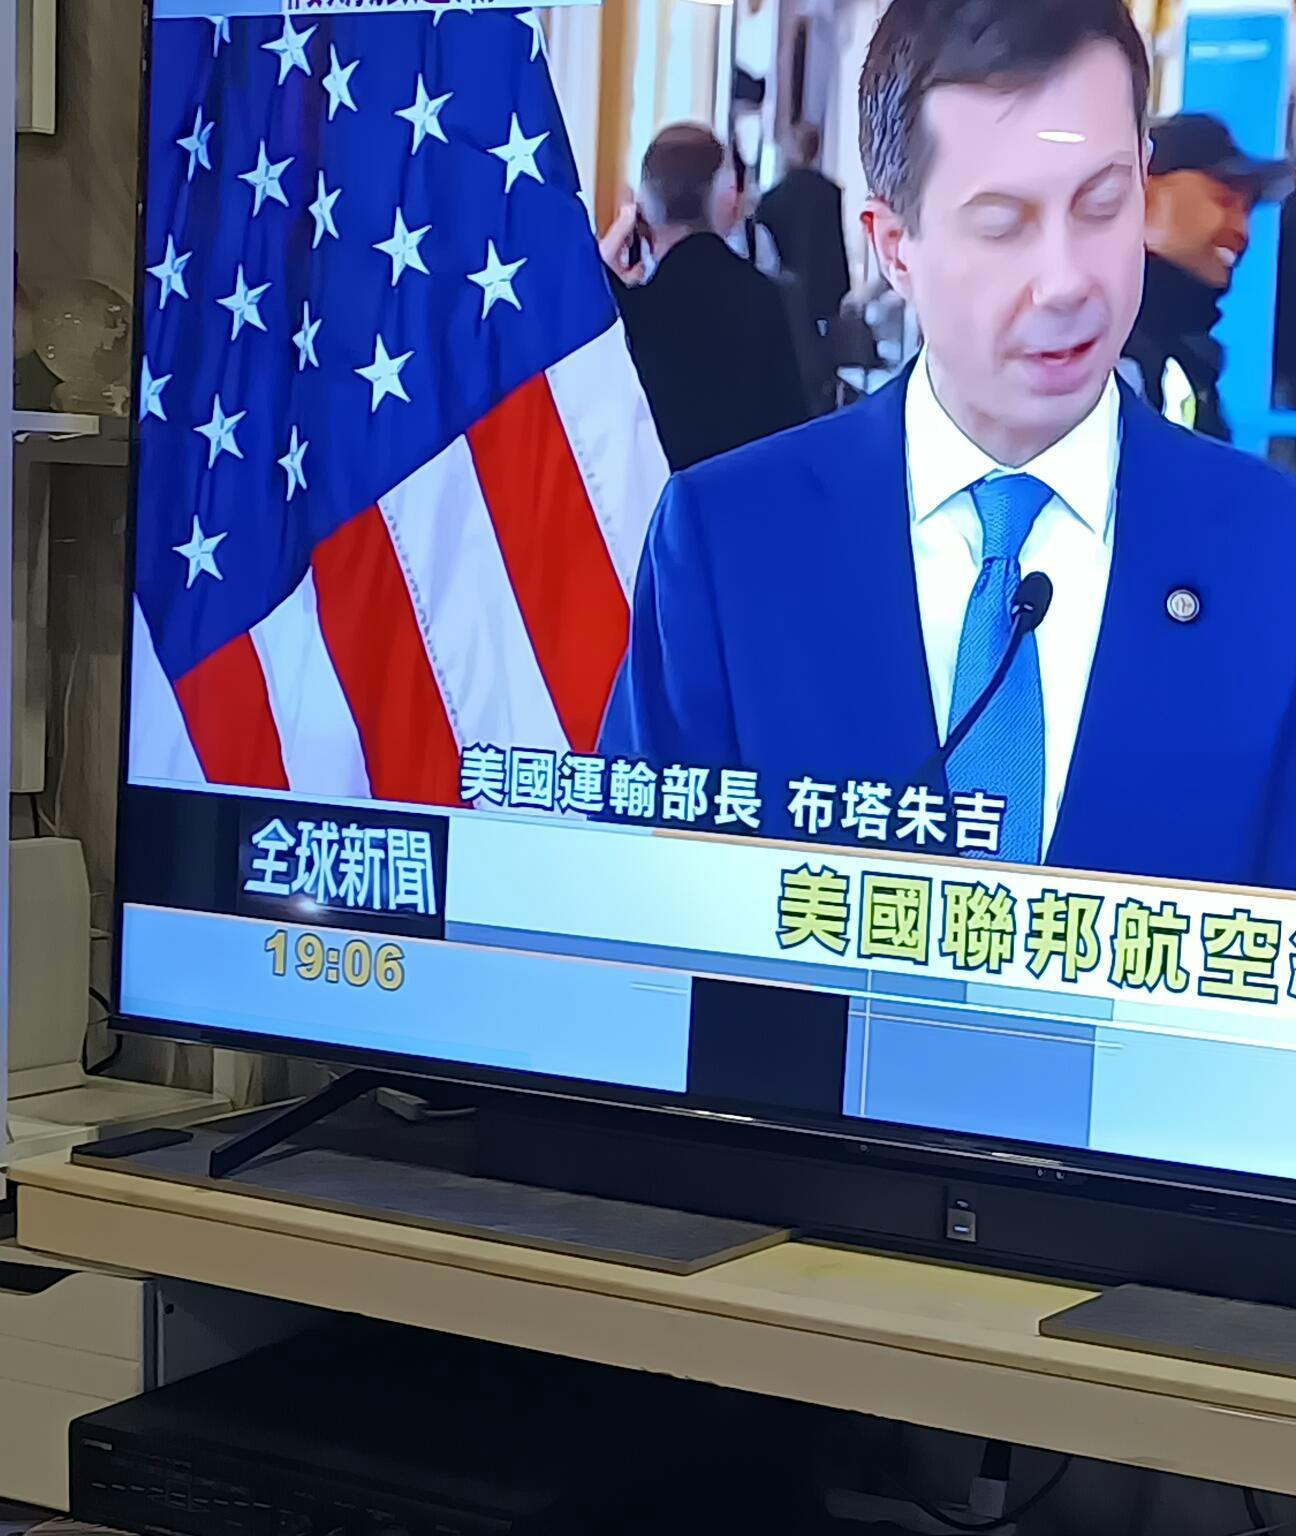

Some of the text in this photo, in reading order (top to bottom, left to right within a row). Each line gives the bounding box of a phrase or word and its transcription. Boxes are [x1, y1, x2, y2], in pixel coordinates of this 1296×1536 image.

[459, 743, 1006, 853] 美國運輸部長 布塔朱吉
[242, 816, 438, 918] 全球新聞
[261, 929, 406, 993] 19:06
